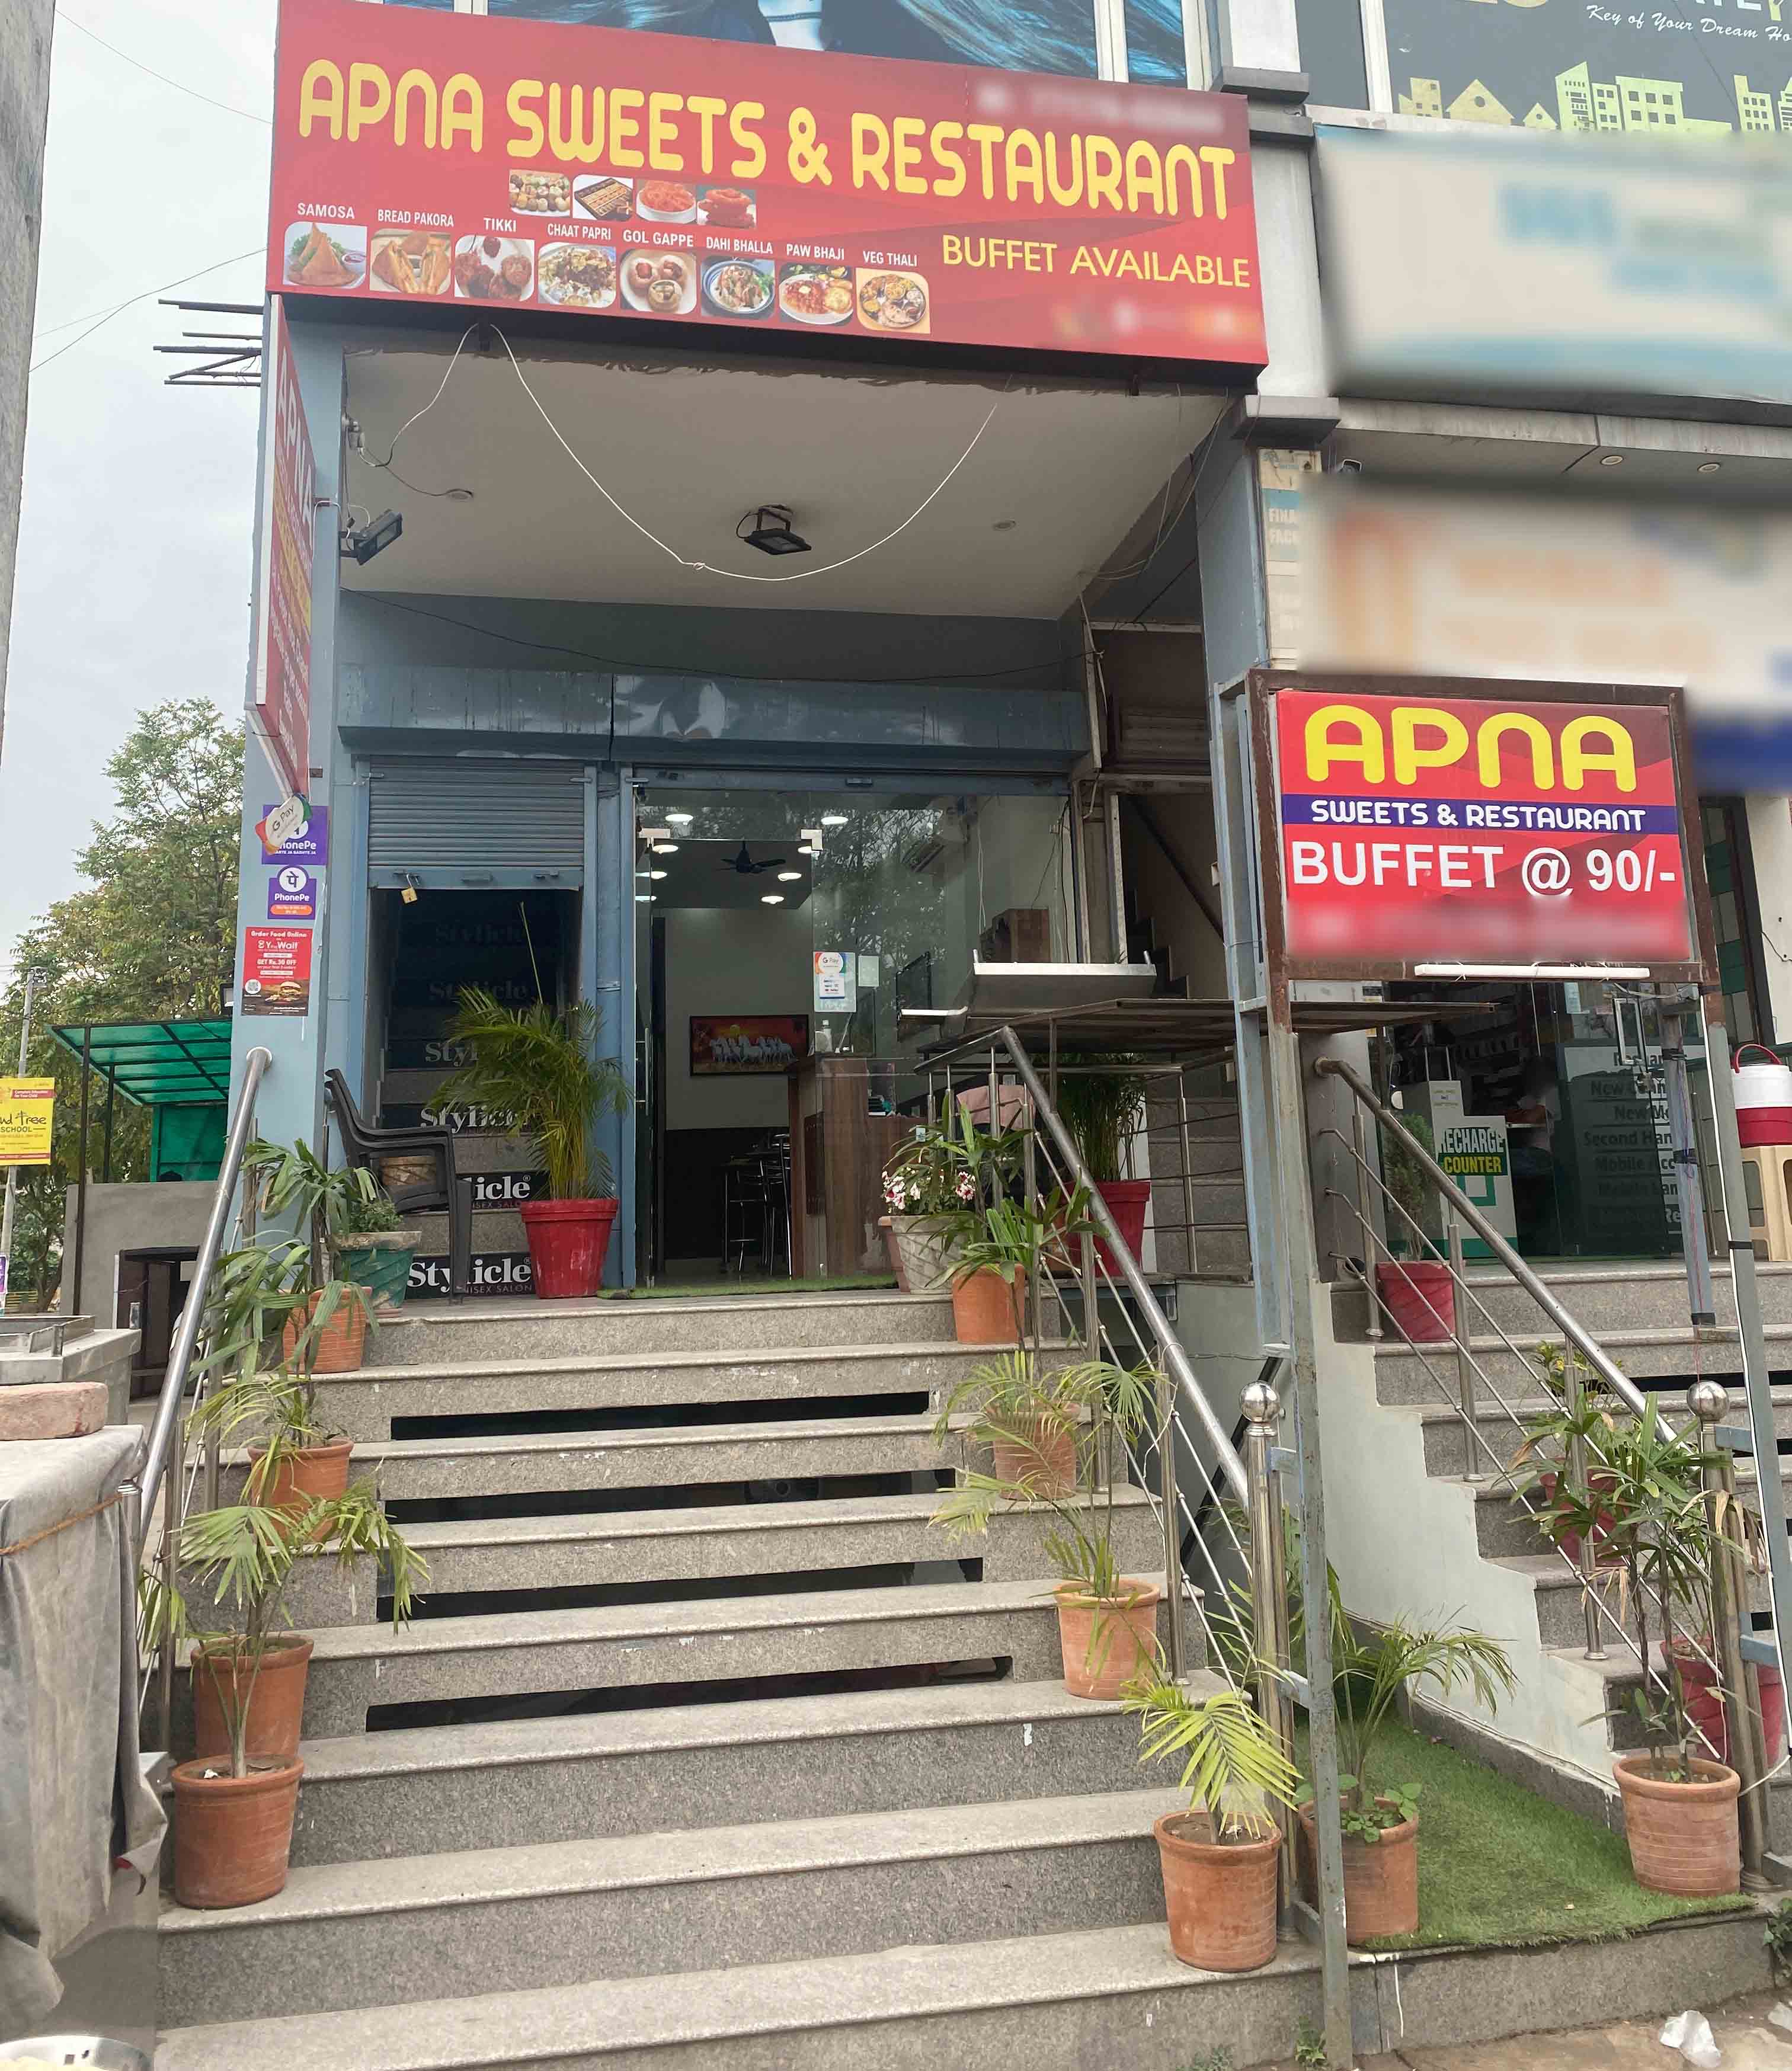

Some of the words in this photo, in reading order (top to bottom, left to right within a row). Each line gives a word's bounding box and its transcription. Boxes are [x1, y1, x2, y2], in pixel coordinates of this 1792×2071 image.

[1586, 5, 1623, 25] Key
[1628, 12, 1644, 29] of
[1651, 12, 1693, 32] Your
[1701, 18, 1758, 39] Dream
[298, 59, 484, 153] APNA
[506, 79, 767, 179] SWEETS
[788, 107, 833, 186] &
[851, 112, 1236, 220] RESTAURANT
[297, 203, 355, 220] SAMOSA
[377, 209, 411, 226] BREAD
[412, 212, 454, 228] PAKORA
[484, 217, 517, 233] TIKKI
[547, 223, 578, 238] CHAAT
[581, 226, 612, 241] PAPRI
[623, 229, 649, 245] GOL
[653, 232, 694, 247] GAPPE
[706, 237, 729, 252] DAHI
[733, 239, 773, 255] BHALLA
[786, 243, 811, 258] PAW
[814, 245, 844, 260] BHAJI
[862, 250, 884, 264] VEG
[887, 252, 918, 267] THALI
[942, 234, 1058, 273] BUFFET
[1070, 245, 1251, 287] AVAILABLE
[1304, 705, 1637, 793] APNA
[1311, 800, 1429, 824] SWEETS
[1438, 804, 1458, 827] &
[1466, 804, 1647, 832] RESTAURANT
[280, 840, 317, 850] onePe
[1291, 841, 1503, 888] BUFFET
[1521, 847, 1574, 897] @
[1586, 849, 1676, 893] 90/-
[274, 893, 310, 901] PhonePe
[1584, 1131, 1637, 1147] Second
[1444, 1155, 1502, 1174] COUNTER
[474, 1176, 530, 1201] icle
[407, 1257, 532, 1293] Styicle
[465, 1285, 494, 1294] NISEX
[497, 1283, 532, 1292] SALON
